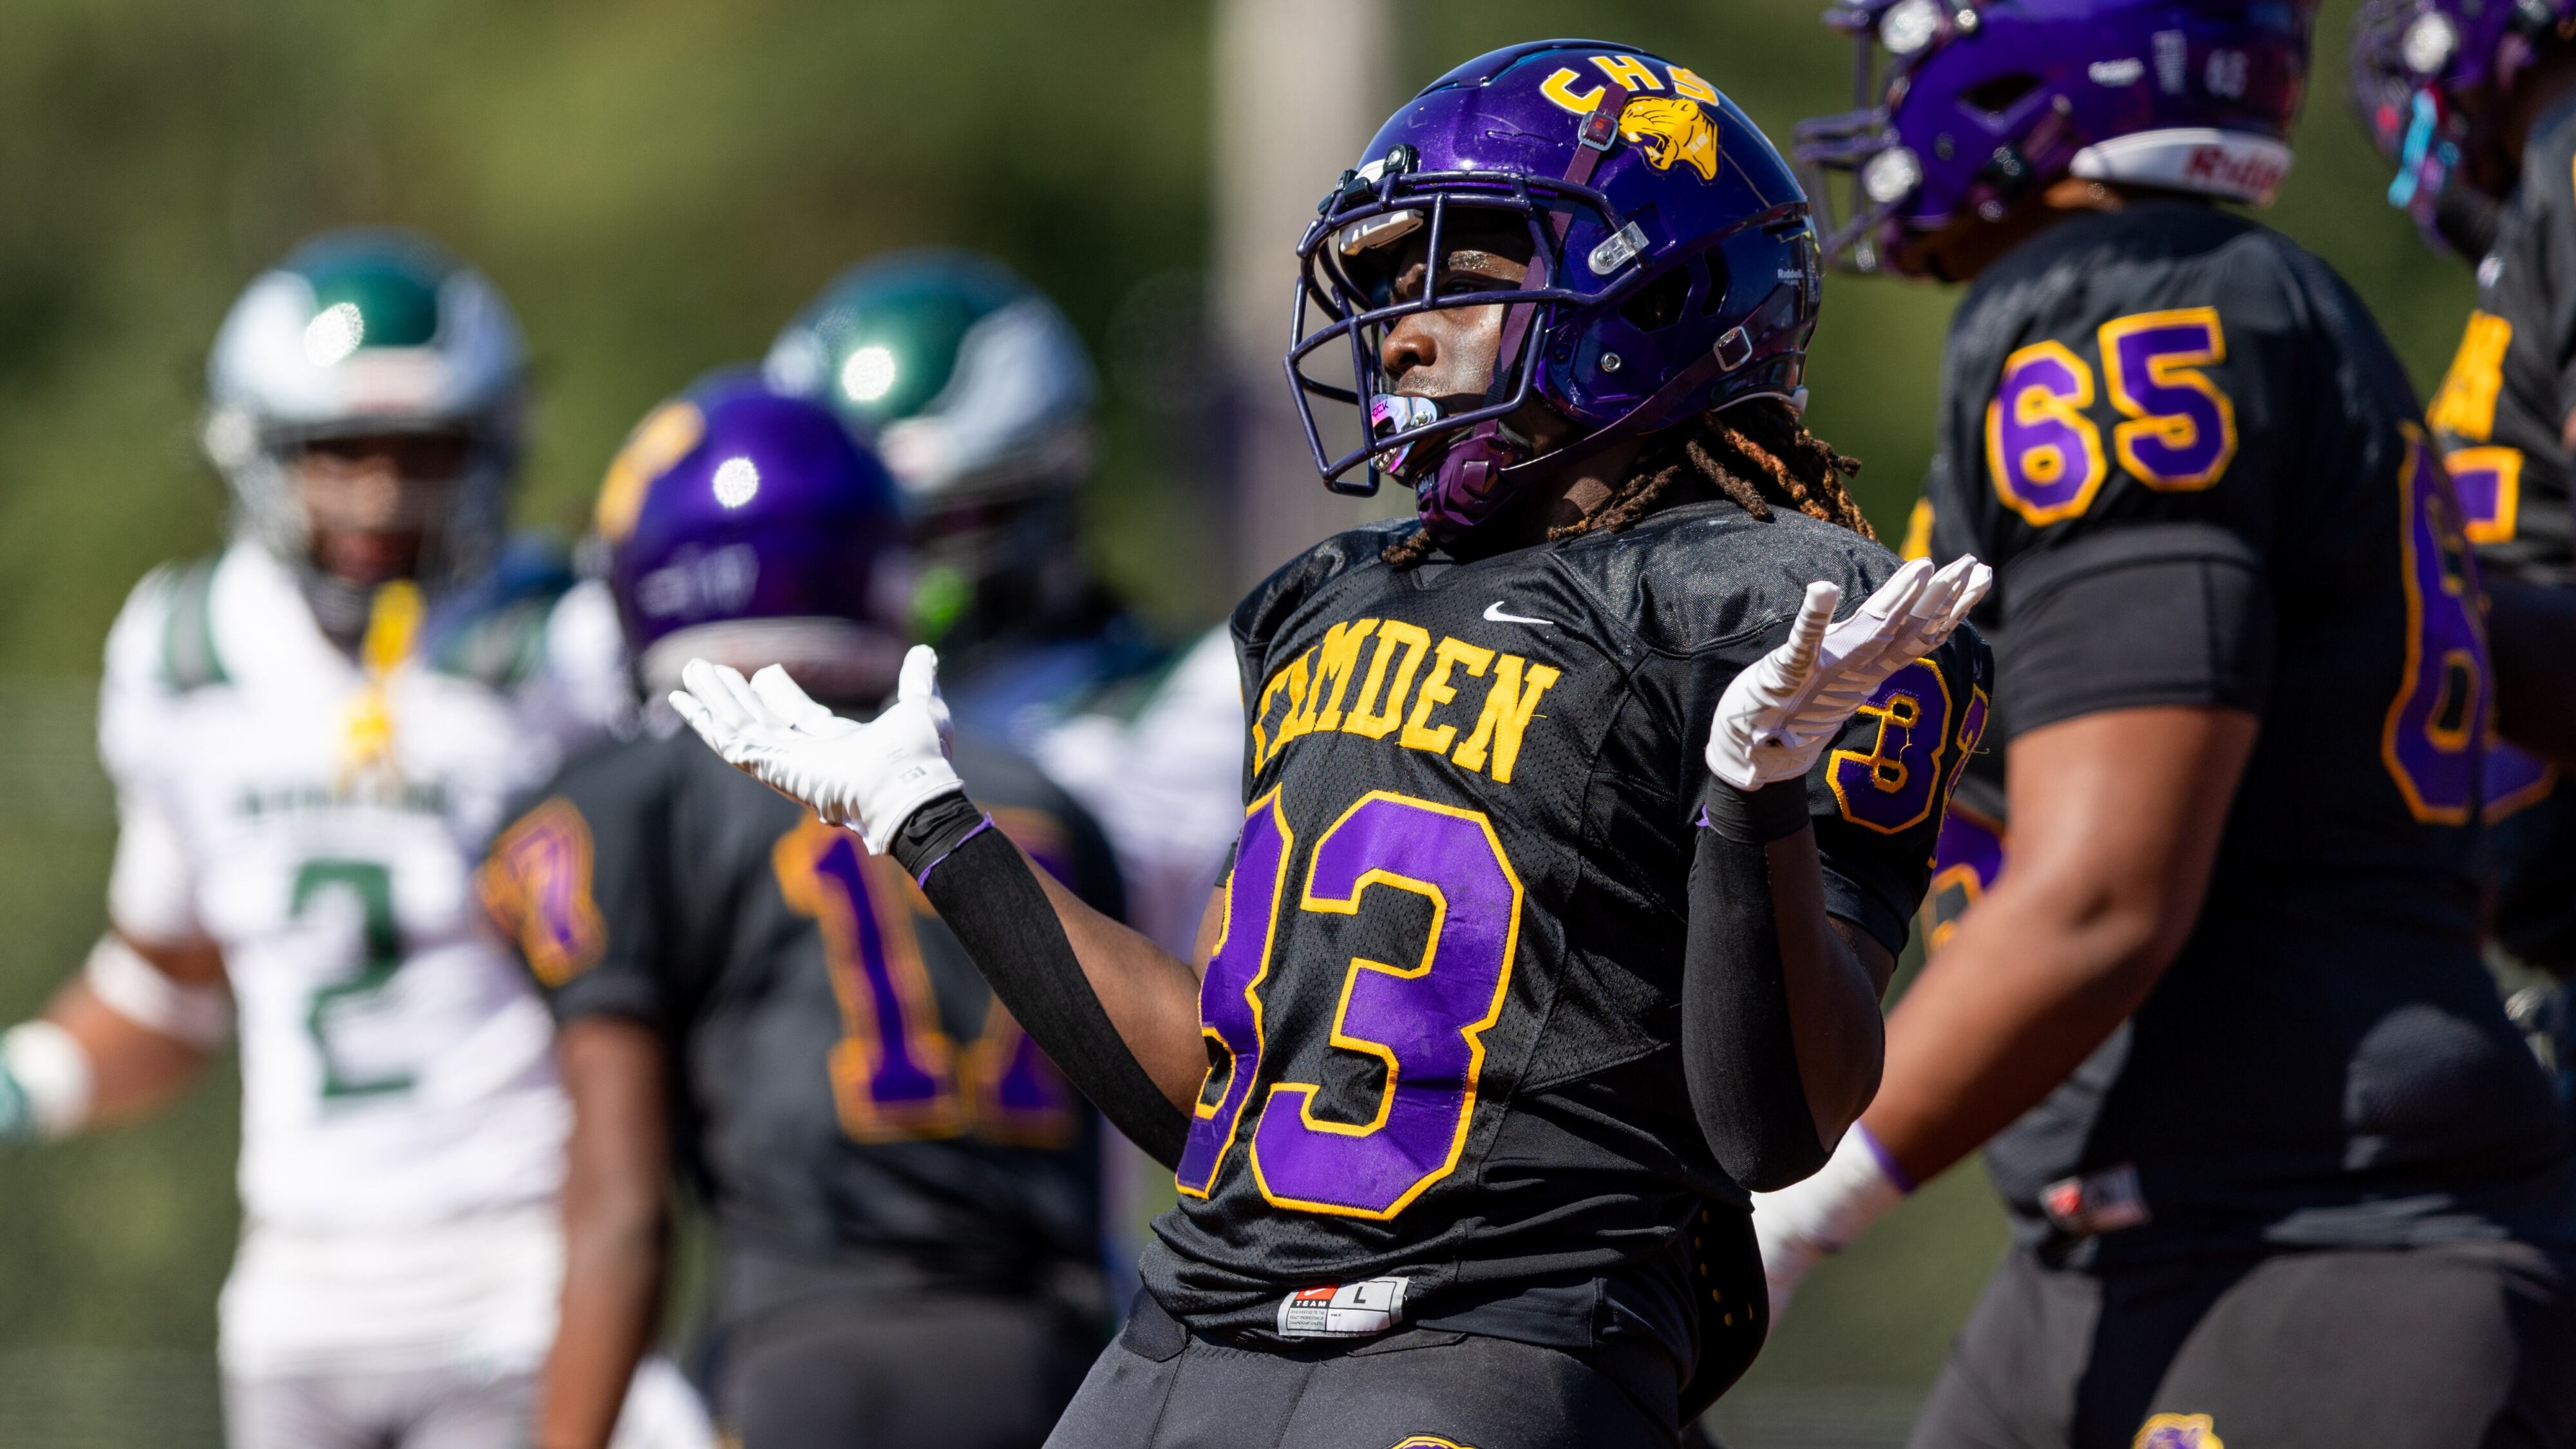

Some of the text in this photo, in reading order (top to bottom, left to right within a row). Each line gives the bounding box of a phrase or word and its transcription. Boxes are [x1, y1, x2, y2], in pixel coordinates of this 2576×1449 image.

[1539, 54, 1720, 115] CHS
[1985, 305, 2238, 524] 65
[286, 855, 424, 1100] 2
[1295, 1300, 1328, 1308] TEAM
[1352, 1285, 1366, 1304] L
